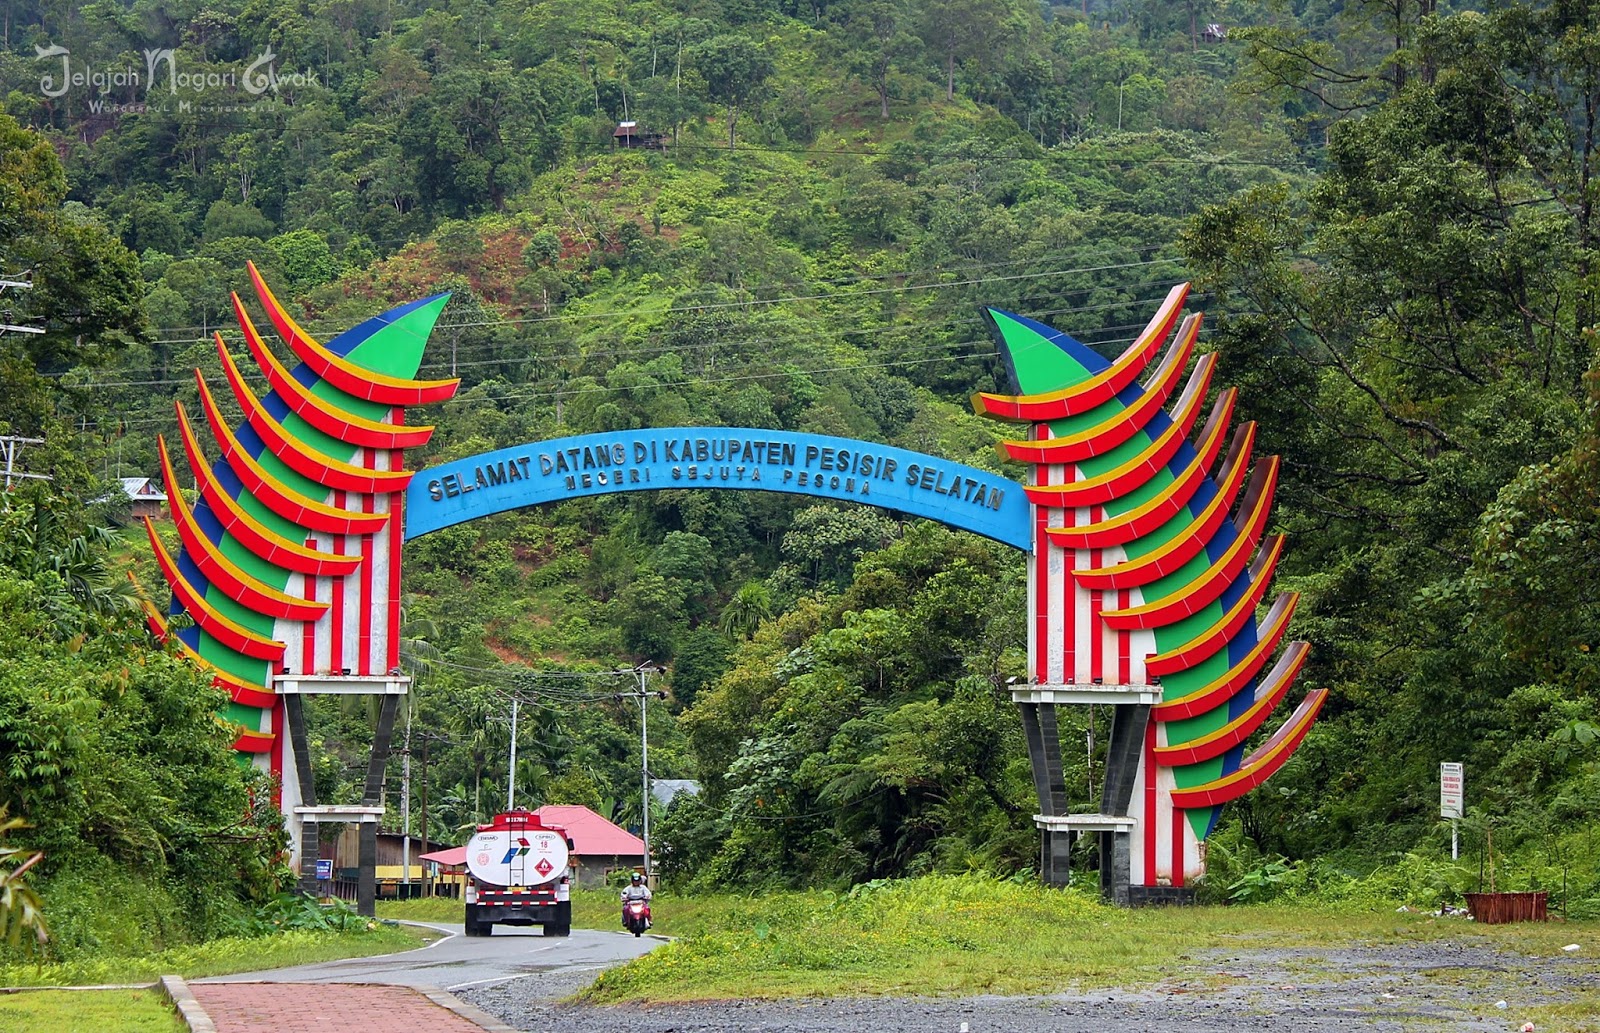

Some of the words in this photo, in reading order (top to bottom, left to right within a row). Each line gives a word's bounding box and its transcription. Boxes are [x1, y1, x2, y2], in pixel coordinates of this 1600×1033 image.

[428, 456, 531, 501] SELAMAT
[539, 443, 626, 476] DATANG
[633, 441, 657, 463] DI
[665, 439, 796, 465] KABUPATEN
[805, 445, 898, 482] PESISIR
[906, 463, 1005, 511] SELATAN
[565, 468, 650, 491] NEGERI
[671, 465, 760, 481] SEJUTA
[783, 469, 870, 495] PESONA
